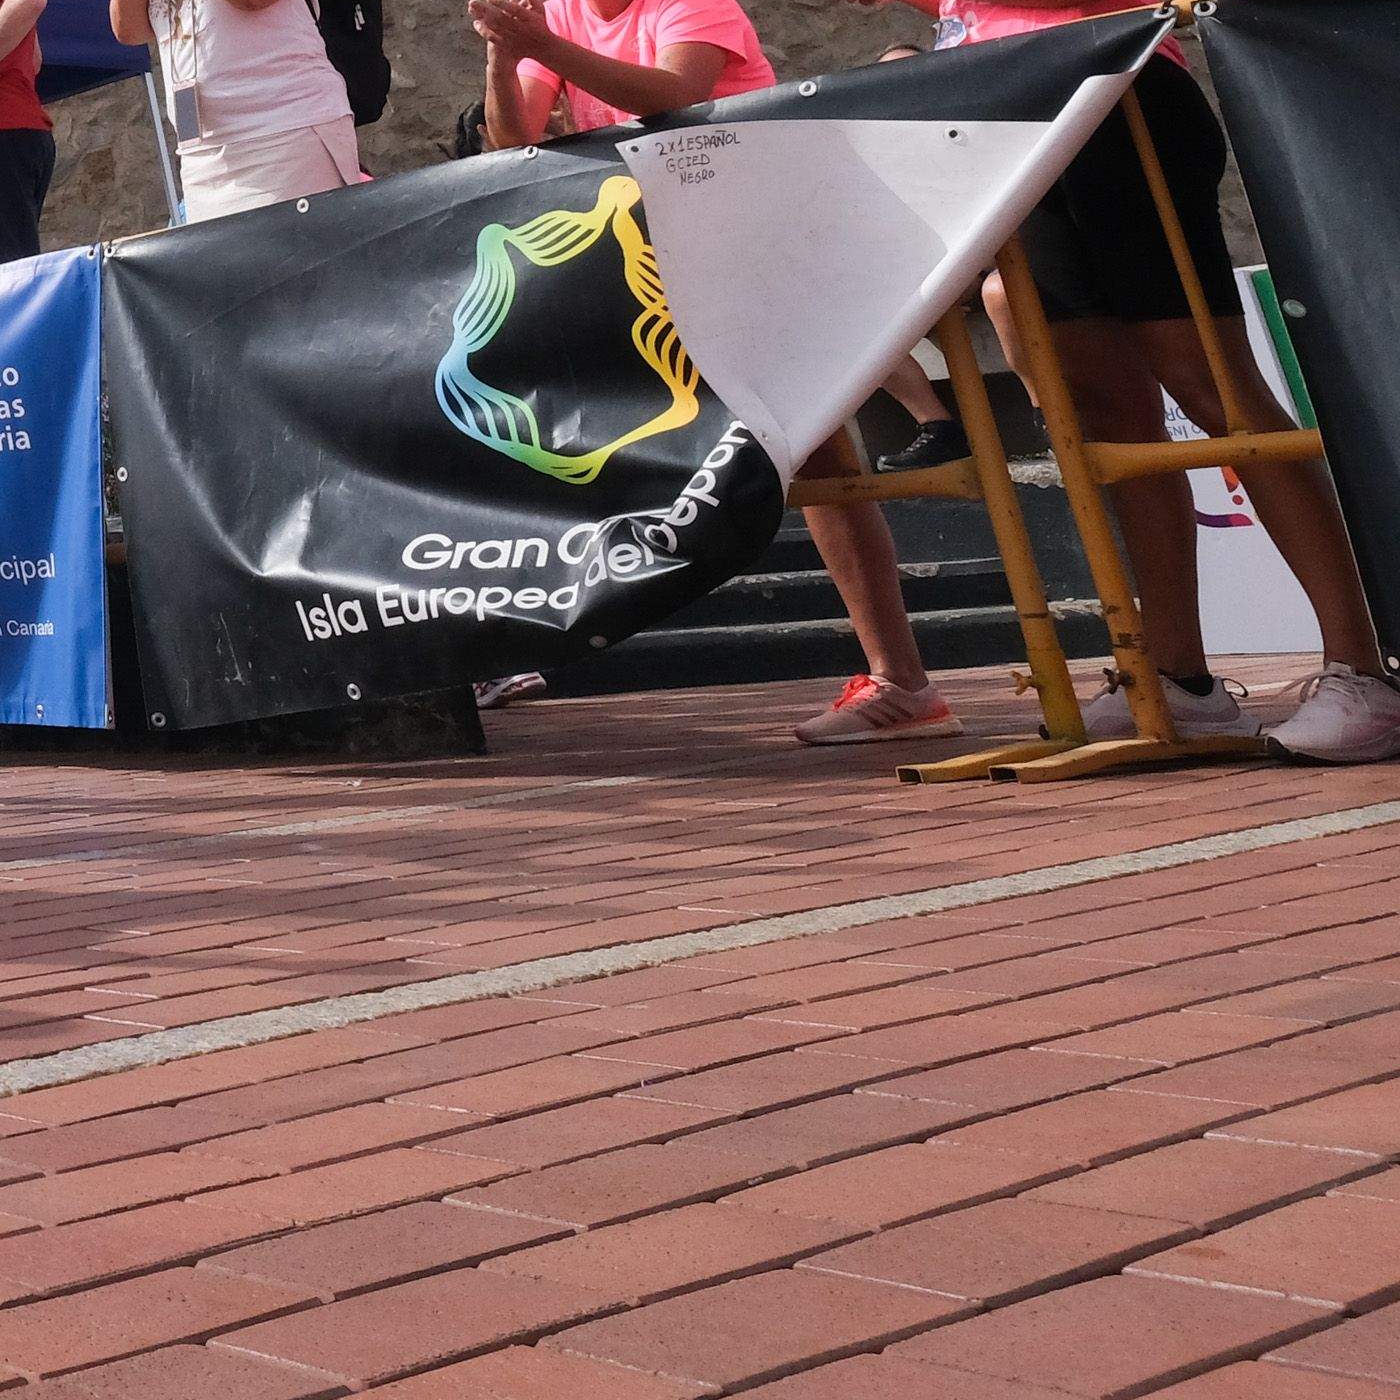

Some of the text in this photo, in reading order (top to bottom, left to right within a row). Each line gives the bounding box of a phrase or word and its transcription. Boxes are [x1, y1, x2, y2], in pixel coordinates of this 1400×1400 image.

[295, 420, 750, 641] Isla Europea del Depor
[401, 533, 550, 570] Gran
[6, 619, 55, 636] Canaria
